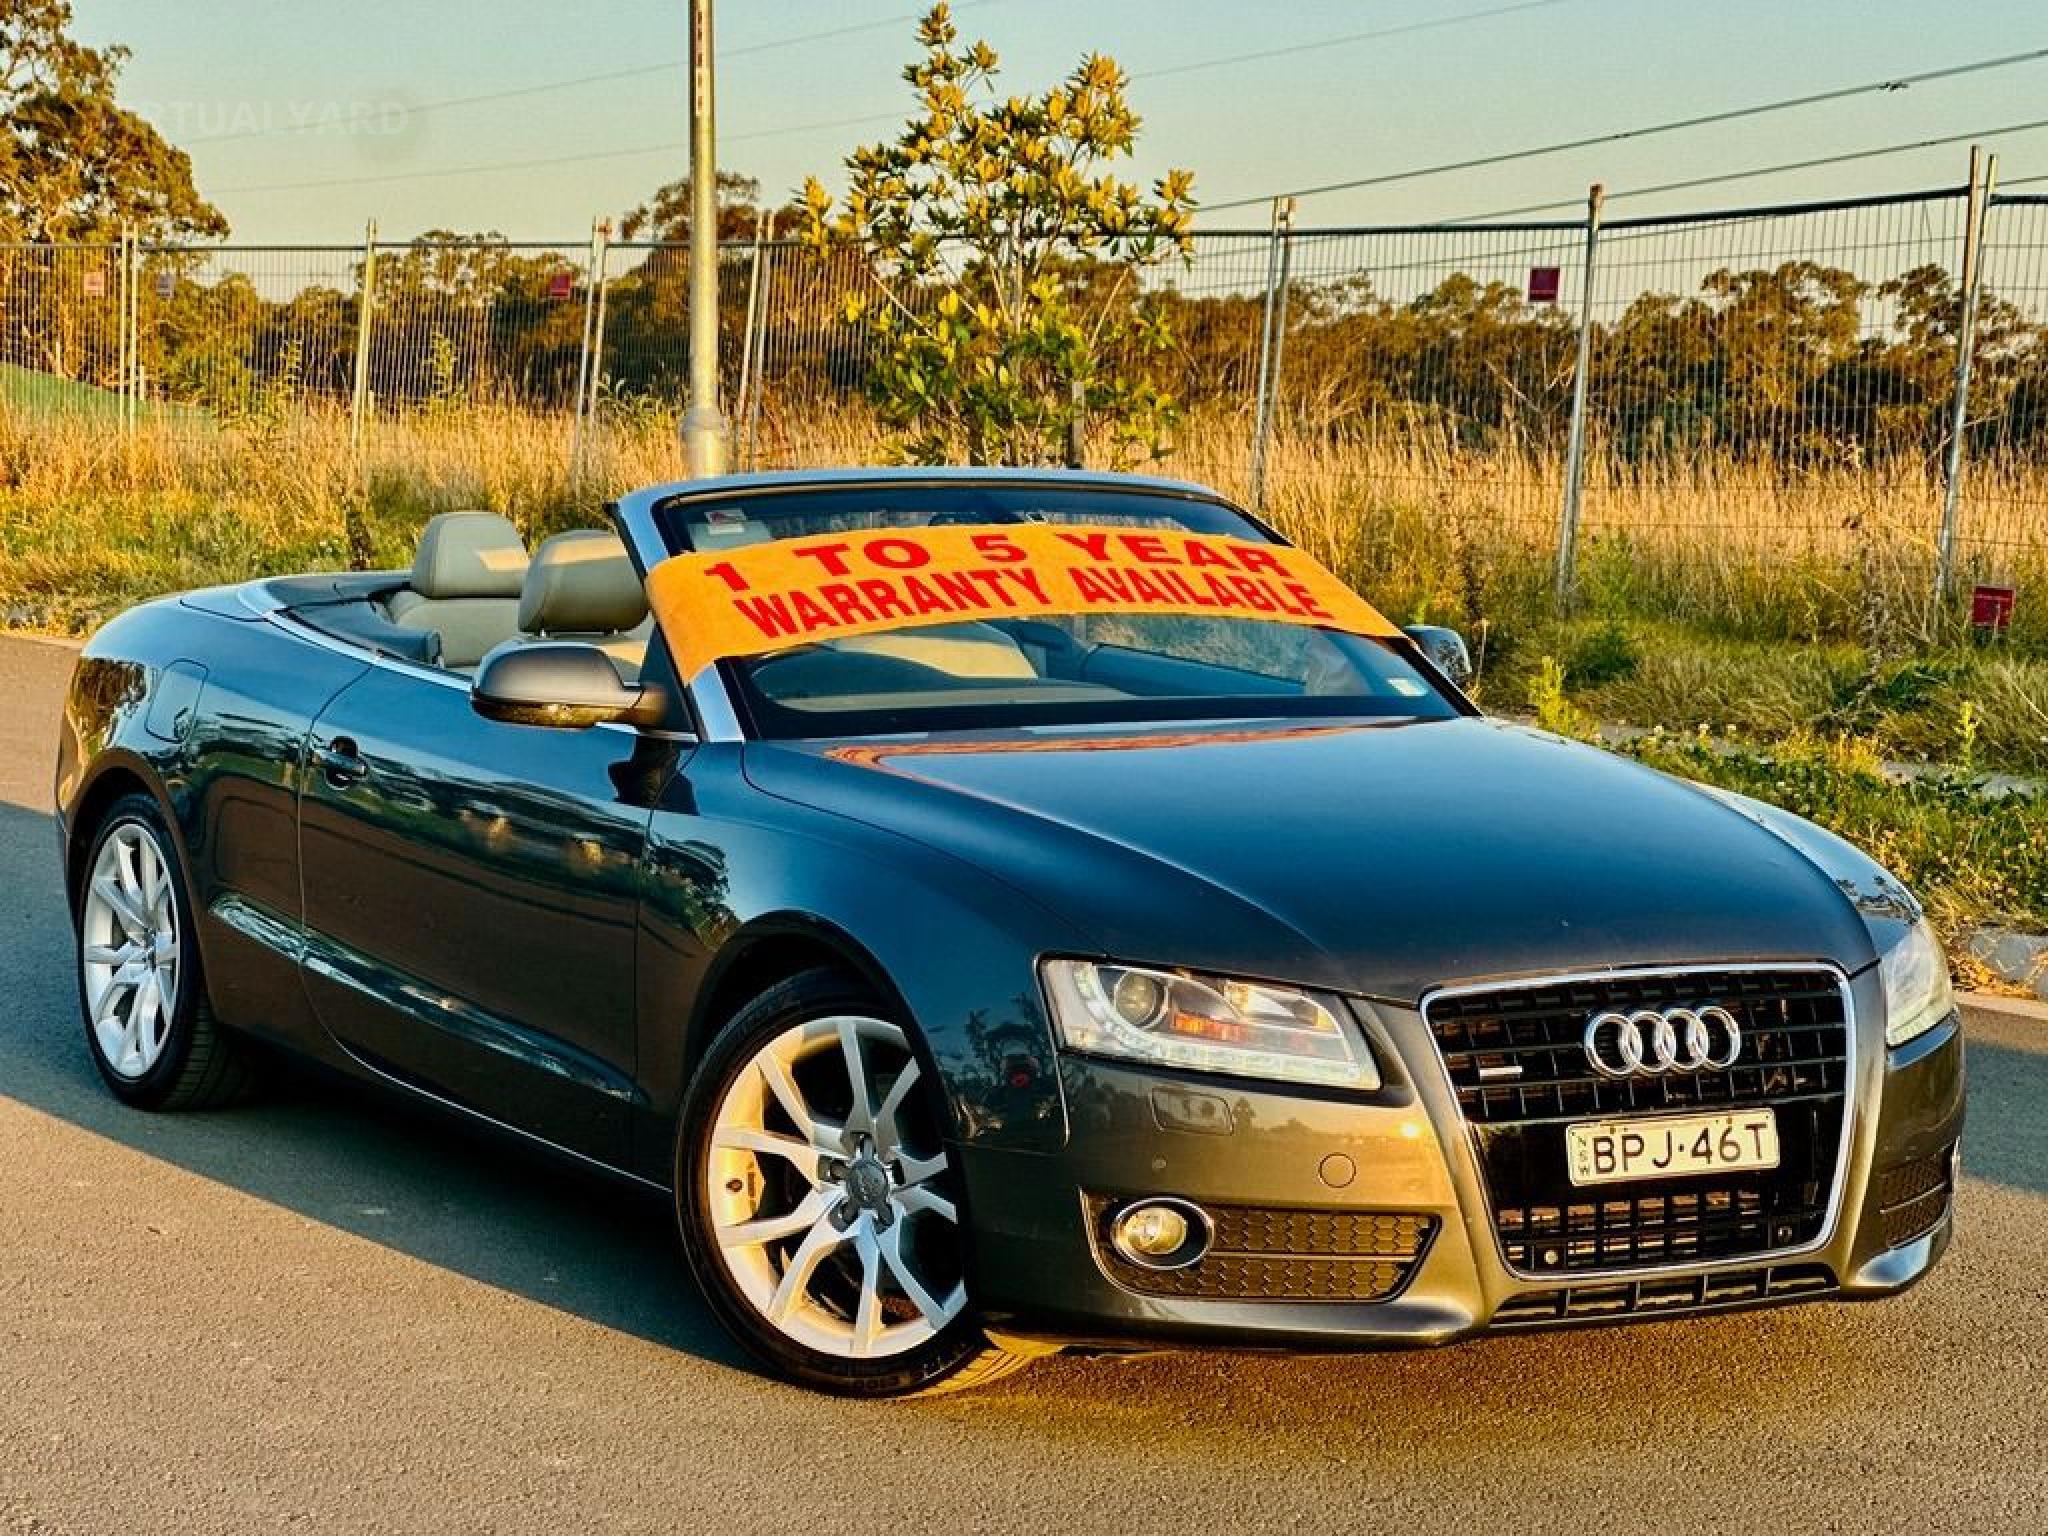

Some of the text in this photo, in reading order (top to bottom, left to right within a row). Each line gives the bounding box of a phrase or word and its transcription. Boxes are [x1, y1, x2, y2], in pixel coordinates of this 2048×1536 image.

[703, 533, 1294, 593] 1 TO 5 YEAR
[733, 567, 1334, 639] WARRANTY AVAILABLE
